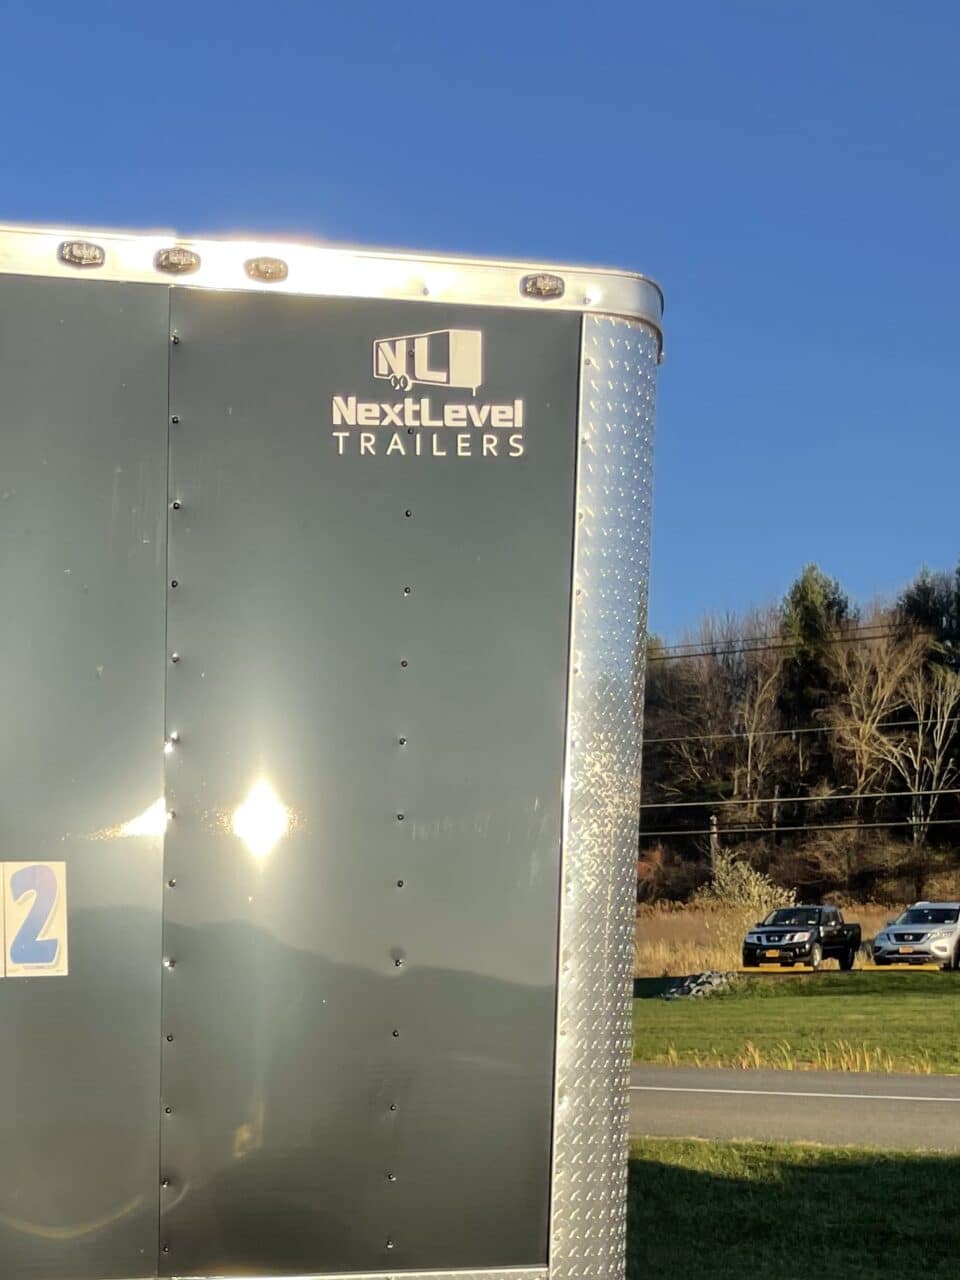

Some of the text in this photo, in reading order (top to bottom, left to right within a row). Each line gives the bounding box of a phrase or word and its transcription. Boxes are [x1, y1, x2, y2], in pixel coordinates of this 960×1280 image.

[377, 337, 448, 382] NL
[332, 396, 523, 427] NextLevel
[332, 432, 524, 457] TRAILERS
